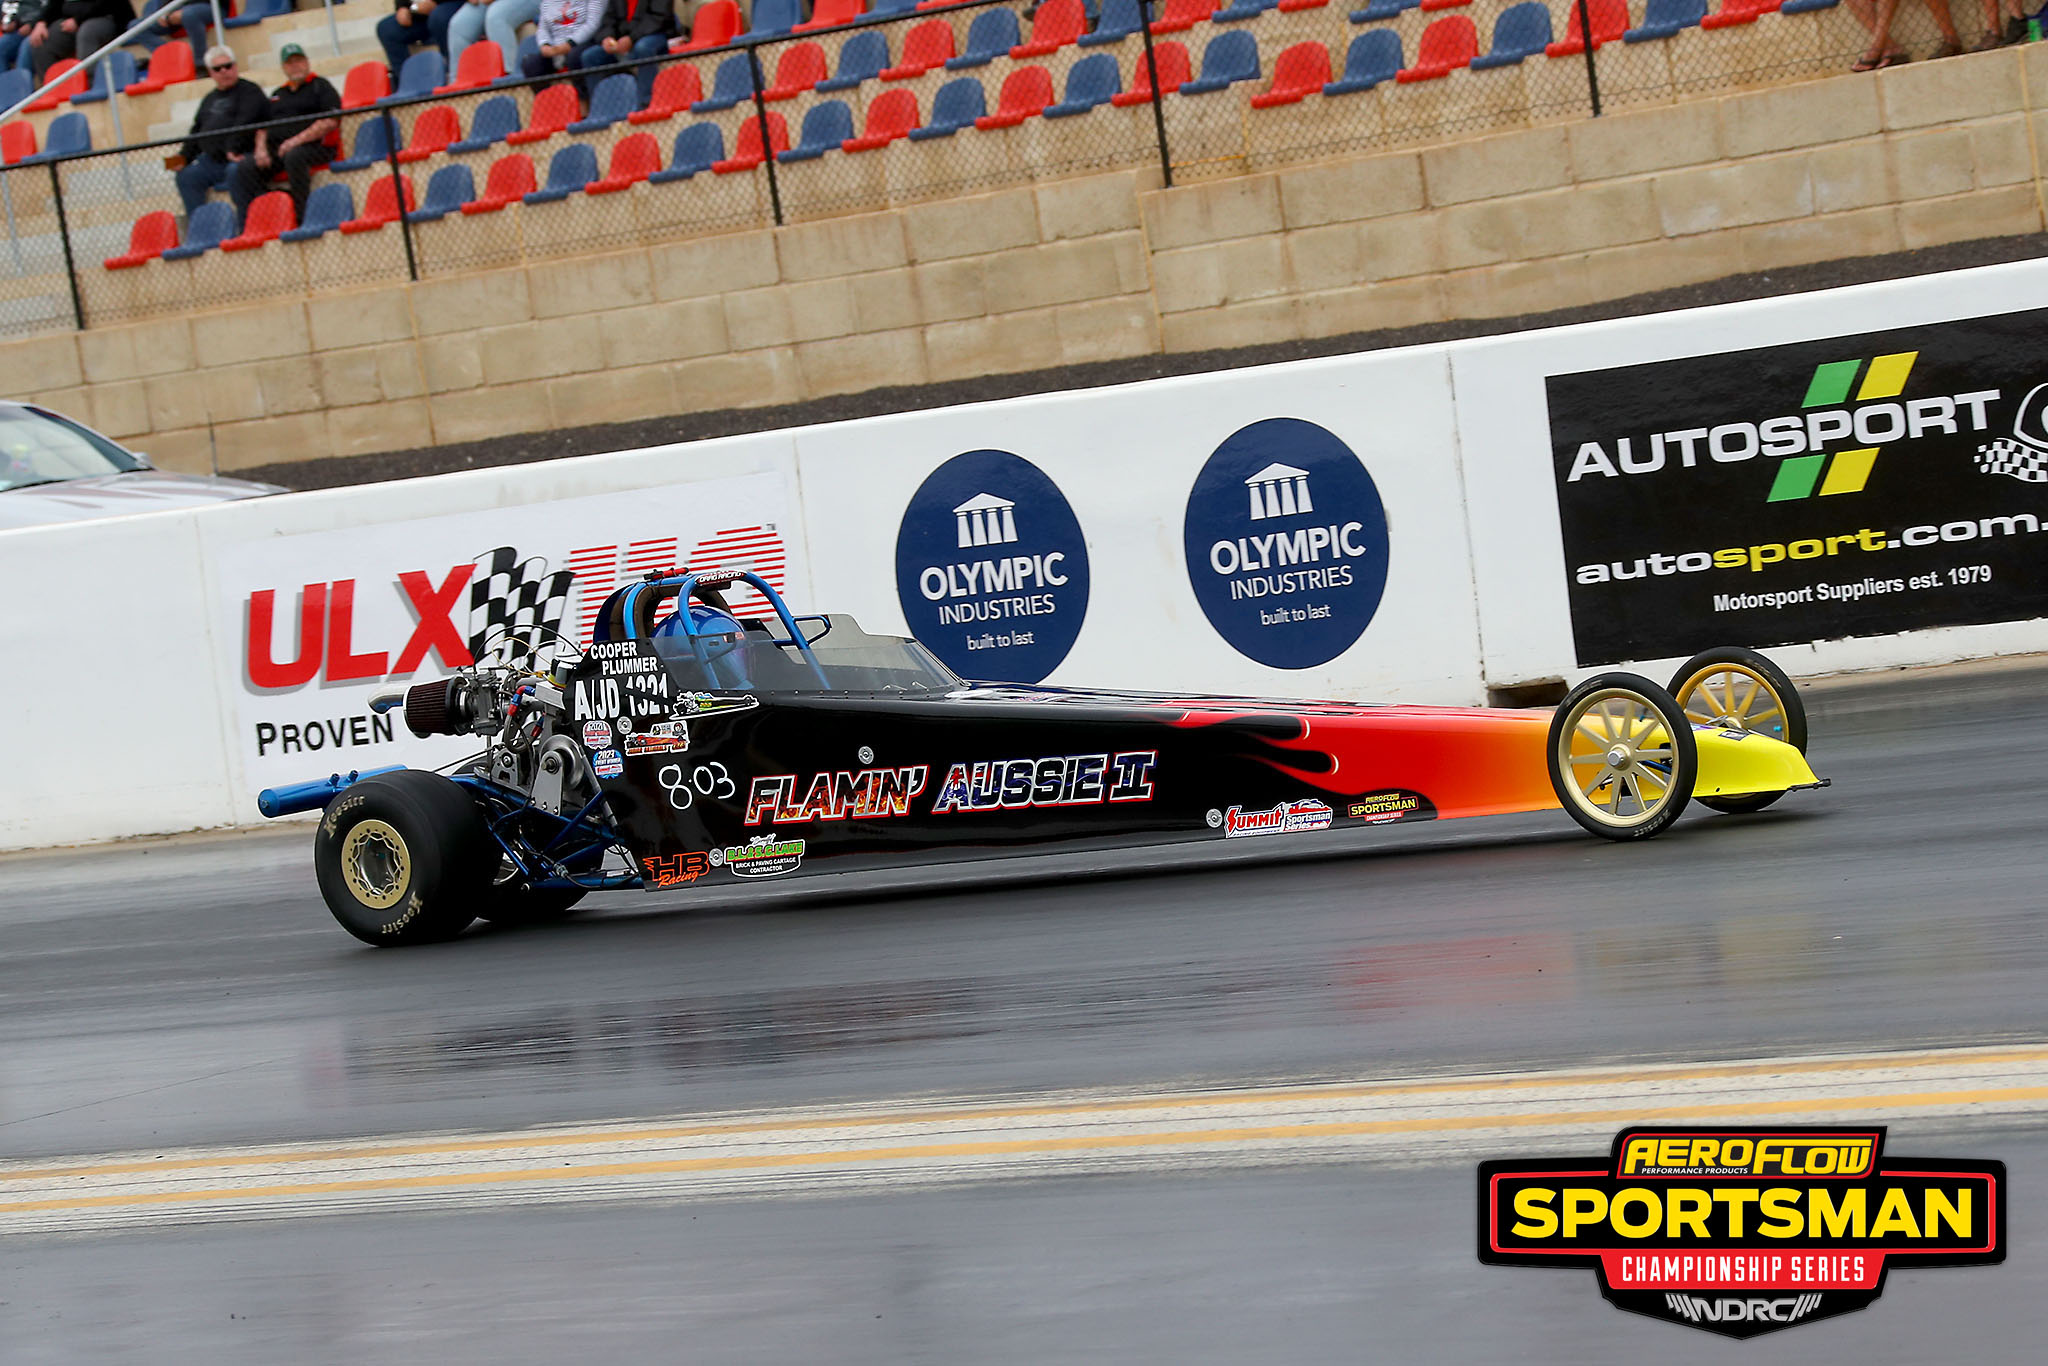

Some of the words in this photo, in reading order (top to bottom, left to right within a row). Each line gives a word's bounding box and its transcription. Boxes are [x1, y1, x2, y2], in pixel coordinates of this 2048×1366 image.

[1567, 389, 2000, 482] AUTOSPORT
[1209, 521, 1367, 575] OLYMPIC
[919, 552, 1069, 601] OLYMPIC
[1230, 564, 1354, 600] INDUSTRIES
[1713, 586, 1814, 612] Motorsport
[1816, 575, 1905, 604] Suppliers
[1908, 570, 1943, 590] est.
[1947, 564, 1992, 586] 1979
[938, 594, 1056, 626] INDUSTRIES
[1260, 607, 1290, 626] built
[1291, 607, 1305, 622] to
[1307, 603, 1332, 620] last
[246, 563, 478, 690] ULX
[967, 633, 995, 652] built
[997, 634, 1010, 648] to
[1012, 630, 1035, 646] last
[590, 641, 638, 660] COOPER
[602, 656, 659, 676] PLUMMER
[256, 713, 394, 757] PROVEN
[598, 750, 615, 760] 2023
[744, 764, 930, 826] FLAMIN'
[931, 753, 1108, 815] AUSSIE
[1286, 812, 1331, 824] Sportsman
[1350, 799, 1417, 815] SPORTSMAN
[775, 841, 803, 855] LAKE
[643, 851, 710, 882] HB
[657, 870, 700, 889] Racing
